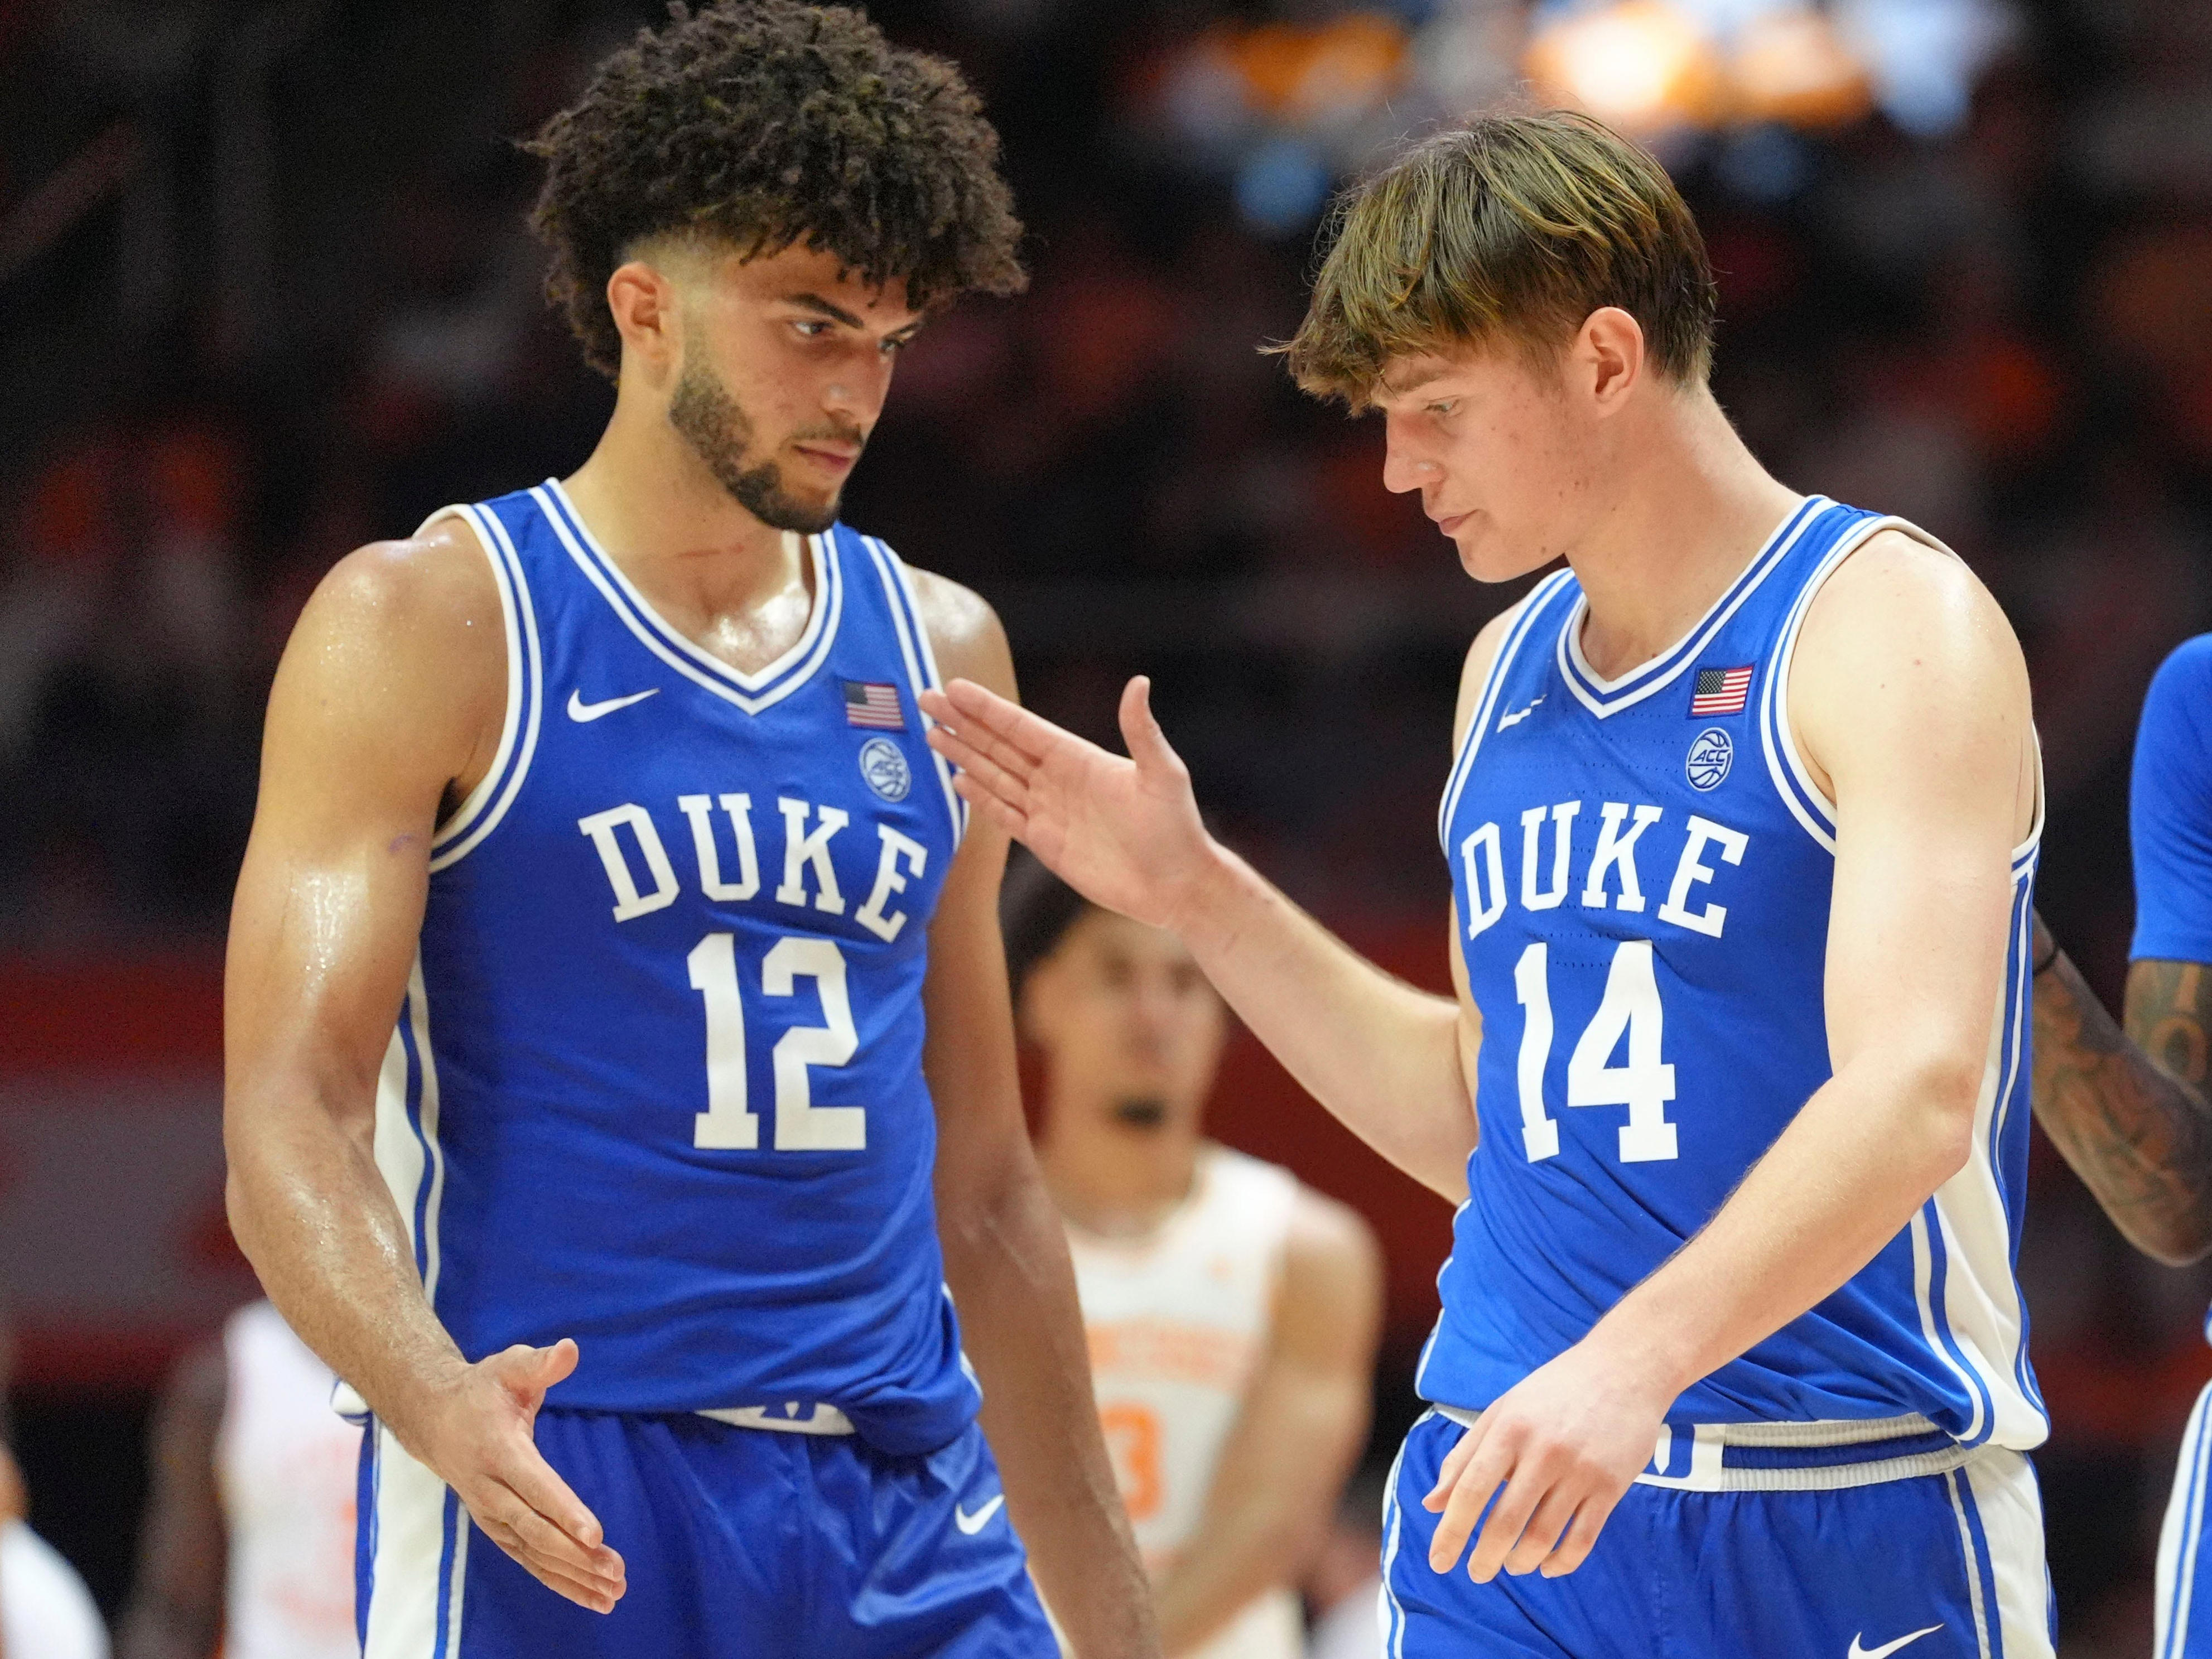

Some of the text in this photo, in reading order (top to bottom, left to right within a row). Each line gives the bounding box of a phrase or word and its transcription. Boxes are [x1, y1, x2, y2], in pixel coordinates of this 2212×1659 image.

[1693, 749, 1731, 762] ACC
[577, 793, 928, 943] DUKE
[1461, 800, 1749, 940] DUKE
[687, 933, 866, 1151] 12
[1514, 940, 1678, 1163] 14
